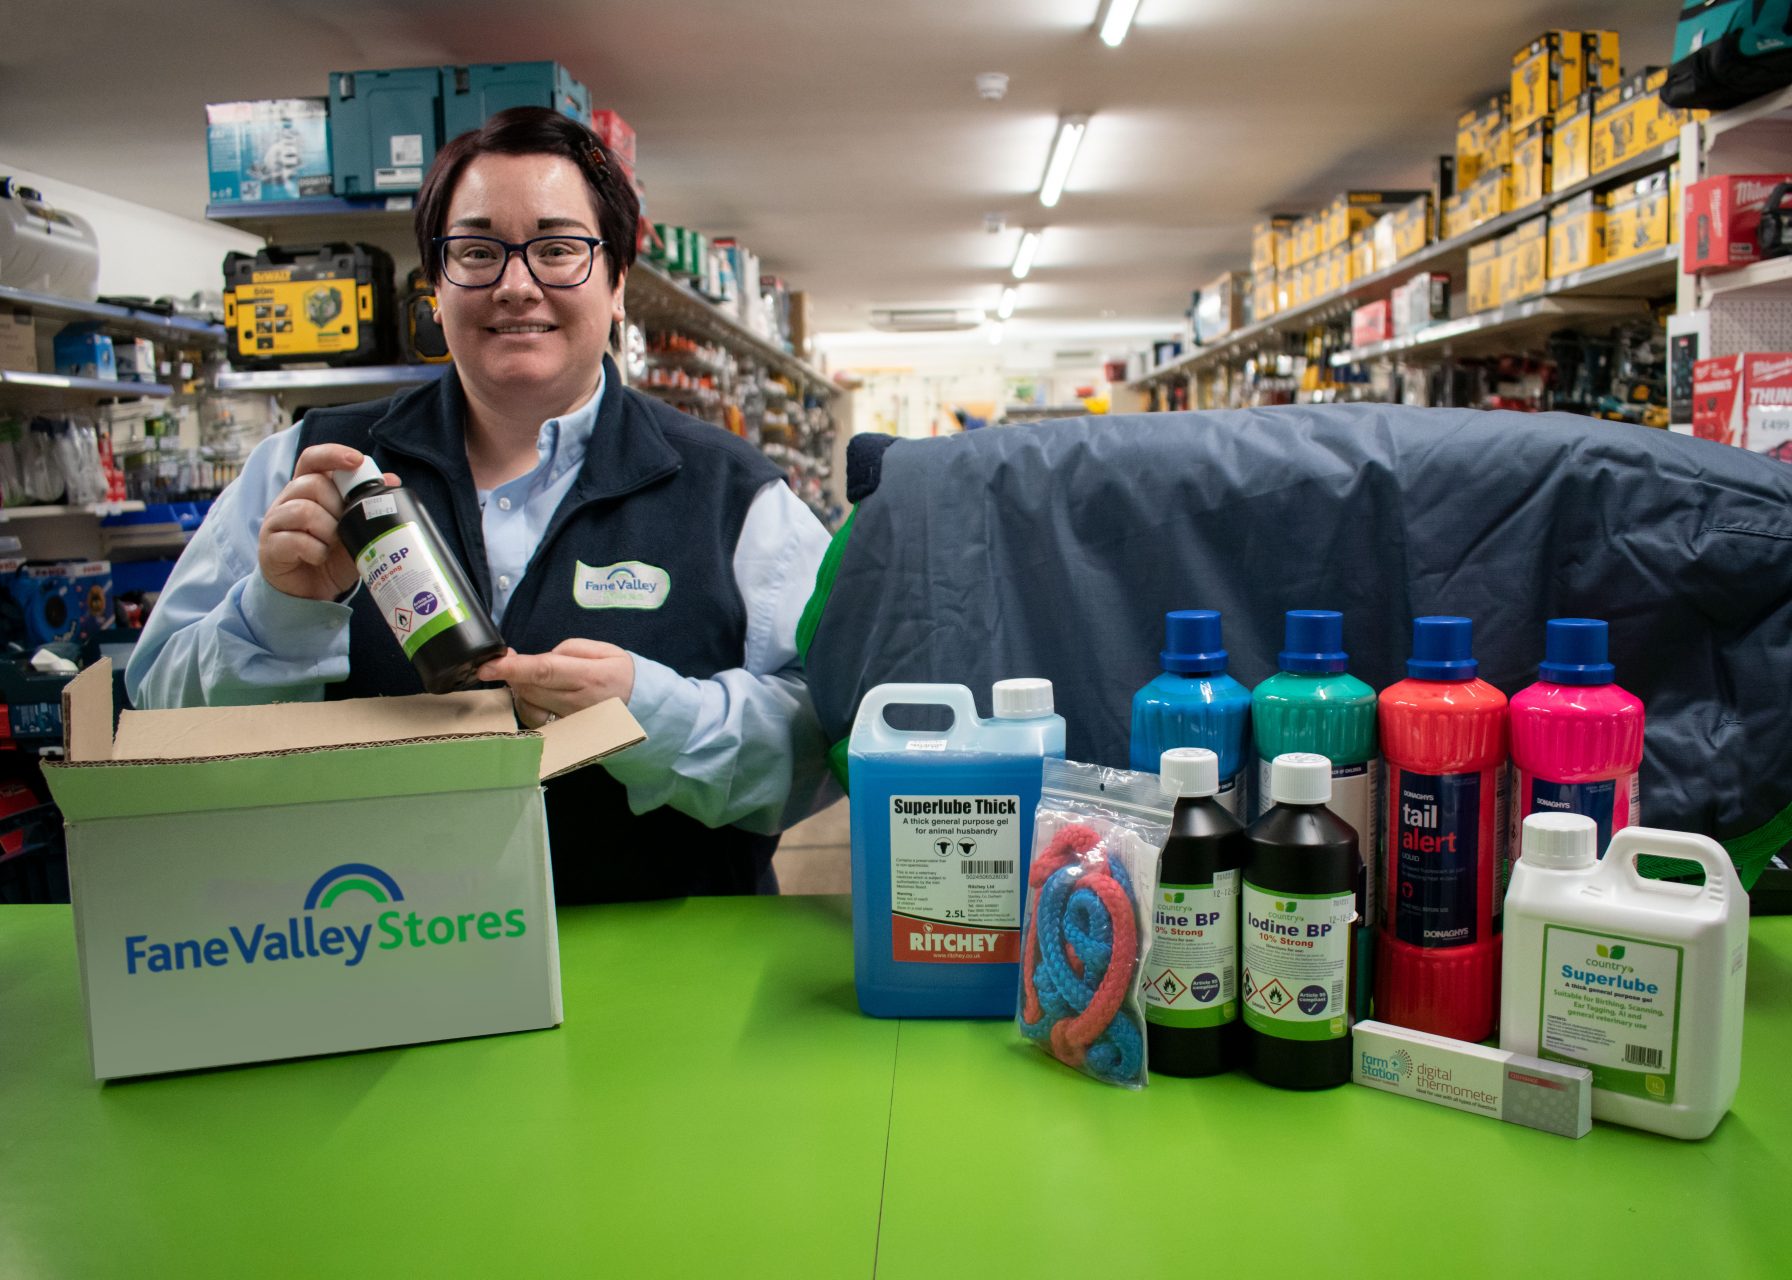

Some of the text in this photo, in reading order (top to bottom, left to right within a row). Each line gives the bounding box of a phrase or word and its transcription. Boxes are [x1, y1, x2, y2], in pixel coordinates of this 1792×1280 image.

[389, 547, 409, 564] BP
[585, 579, 657, 593] Fane Valley
[1403, 790, 1434, 801] DONAGHYS
[1536, 797, 1570, 809] DONAGHYS
[894, 798, 1016, 816] Superlube Thick
[931, 818, 961, 826] general
[996, 818, 1009, 826] gel
[1402, 803, 1438, 829] tail
[956, 828, 998, 836] husbandry
[1403, 827, 1457, 853] alert
[945, 910, 966, 918] 2.5L
[1195, 912, 1220, 926] BP
[1268, 911, 1299, 923] country
[1155, 926, 1204, 937] 0% Strong
[1248, 912, 1332, 937] Iodine BP
[1423, 928, 1469, 938] DONAGHYS
[125, 909, 527, 974] Fane Valley Stores
[909, 932, 1000, 952] RITCHEY
[1259, 932, 1314, 948] 10% Strong
[1585, 958, 1628, 974] country
[1561, 964, 1659, 994] Superlube
[1571, 983, 1587, 991] thick
[1588, 986, 1613, 996] general
[1613, 991, 1641, 1002] purpose
[1553, 989, 1664, 1017] Suitable for Birthing, Scanning,
[1573, 1001, 1585, 1009] Ear
[1586, 1003, 1617, 1016] Tagging,
[1627, 1011, 1642, 1020] and
[1567, 1009, 1647, 1030] general veterinary use
[1361, 1051, 1388, 1068] farm
[1361, 1064, 1399, 1081] station
[1417, 1062, 1452, 1081] digital
[1417, 1075, 1498, 1105] thermometer
[1458, 1098, 1471, 1106] types
